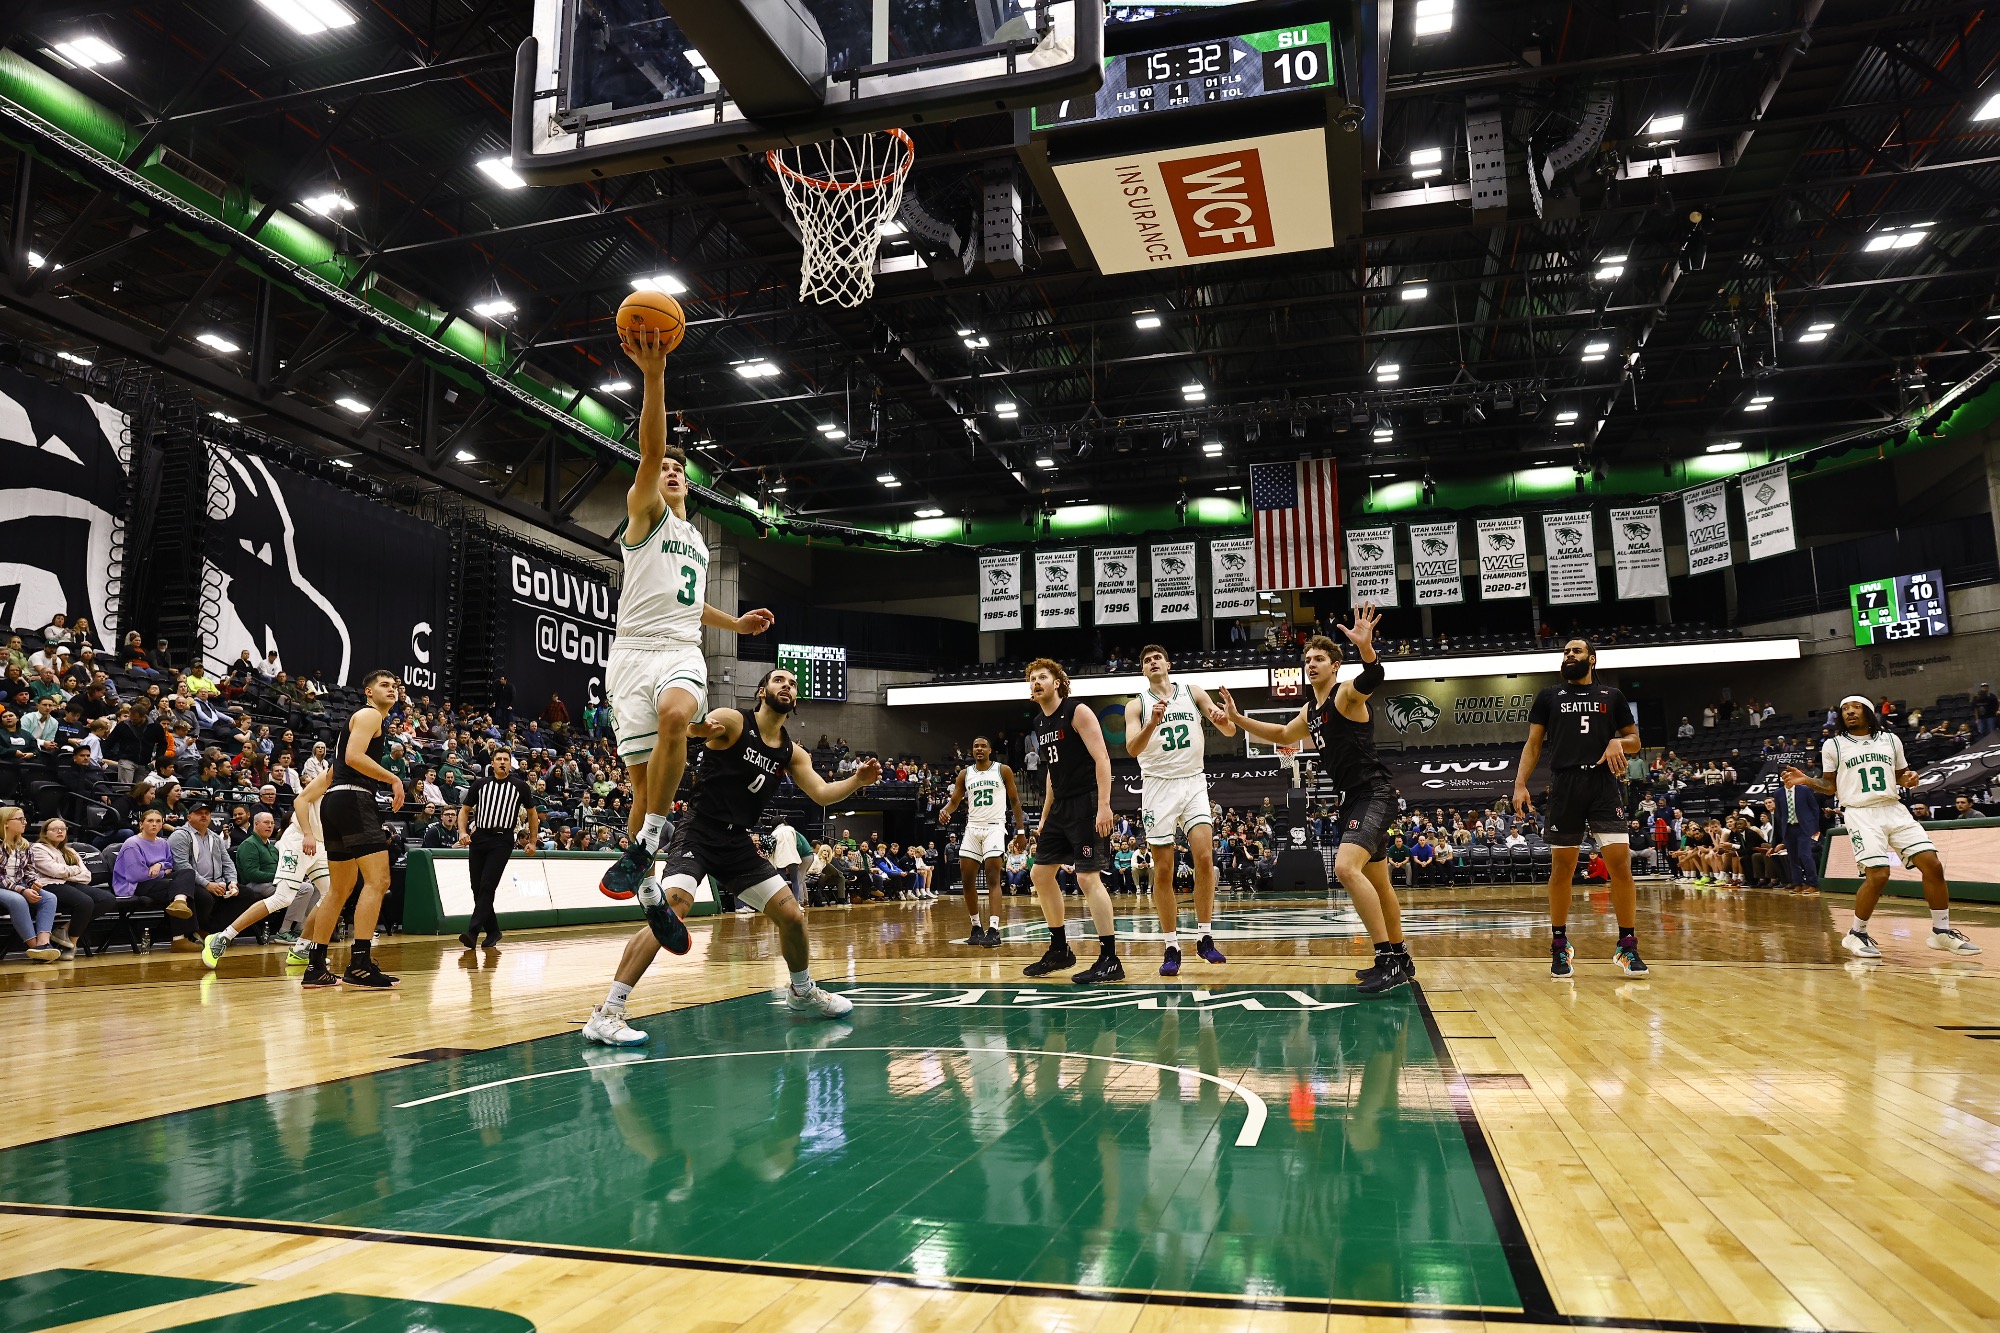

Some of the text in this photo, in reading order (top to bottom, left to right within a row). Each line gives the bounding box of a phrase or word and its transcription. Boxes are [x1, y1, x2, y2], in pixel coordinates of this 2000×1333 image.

[1277, 30, 1308, 48] SU
[1147, 44, 1222, 81] 15:32
[1273, 50, 1319, 84] 10
[1205, 74, 1242, 87] 01 FLS
[1116, 87, 1153, 101] FLS 00
[1174, 84, 1182, 96] 1
[1208, 87, 1244, 100] 4 TOL
[1170, 96, 1190, 105] PER
[1116, 101, 1150, 114] TOL 4
[1182, 160, 1257, 245] WCF
[1115, 164, 1173, 262] INSURANCE
[1743, 465, 1786, 483] UTAH VALLEY
[1701, 485, 1723, 495] VALLEY
[1632, 508, 1658, 516] VALLEY
[1690, 522, 1726, 545] WAC
[1557, 547, 1583, 555] NJCAA
[1628, 542, 1650, 550] NCAA
[1690, 540, 1729, 555] CHAMPIONS
[1548, 553, 1593, 561] ALL-AMERICANS
[1617, 548, 1662, 556] ALL-AMERICANS
[997, 556, 1020, 564] VALLEY
[1482, 554, 1525, 571] WAC
[1692, 552, 1729, 569] 2022-23
[1416, 559, 1457, 576] WAC
[1350, 569, 1394, 578] CHAMPIONS
[1482, 571, 1528, 580] CHAMPIONS
[1911, 573, 1927, 584] SU
[677, 565, 697, 607] 3
[1097, 580, 1124, 588] REGION
[1357, 578, 1389, 586] 2010-11
[1415, 576, 1460, 586] CHAMPIONS
[991, 587, 1009, 595] ICAC
[1045, 584, 1069, 592] SWAC
[1096, 587, 1136, 595] CHAMPIONS
[1213, 586, 1255, 595] CHAMPIONS
[1358, 588, 1389, 596] 2011-12
[1484, 582, 1527, 593] 2020-21
[1860, 582, 1881, 593] UVU
[1910, 583, 1933, 600] 10
[981, 594, 1020, 603] CHAMPIONS
[1037, 591, 1077, 599] CHAMPIONS
[1153, 590, 1195, 599] CHAMPIONS
[1419, 588, 1459, 599] 2013-14
[1215, 599, 1255, 609] 2006-07
[1865, 592, 1877, 608] 7
[1040, 607, 1076, 617] 1995-96
[1104, 603, 1130, 613] 1996
[1160, 603, 1190, 614] 2004
[983, 610, 1018, 619] 1985-86
[814, 646, 845, 655] SEATTLE
[1454, 693, 1533, 710] HOME OF
[1580, 715, 1590, 734] 5
[1160, 724, 1190, 751] 32
[1047, 745, 1059, 764] 33
[1845, 753, 1892, 769] WOLVERINES
[1420, 760, 1509, 774] UVU
[1231, 769, 1279, 778] BANK
[748, 774, 766, 793] 0
[968, 780, 999, 790] WOLVERINES
[1858, 766, 1886, 793] 13
[973, 789, 993, 807] 25
